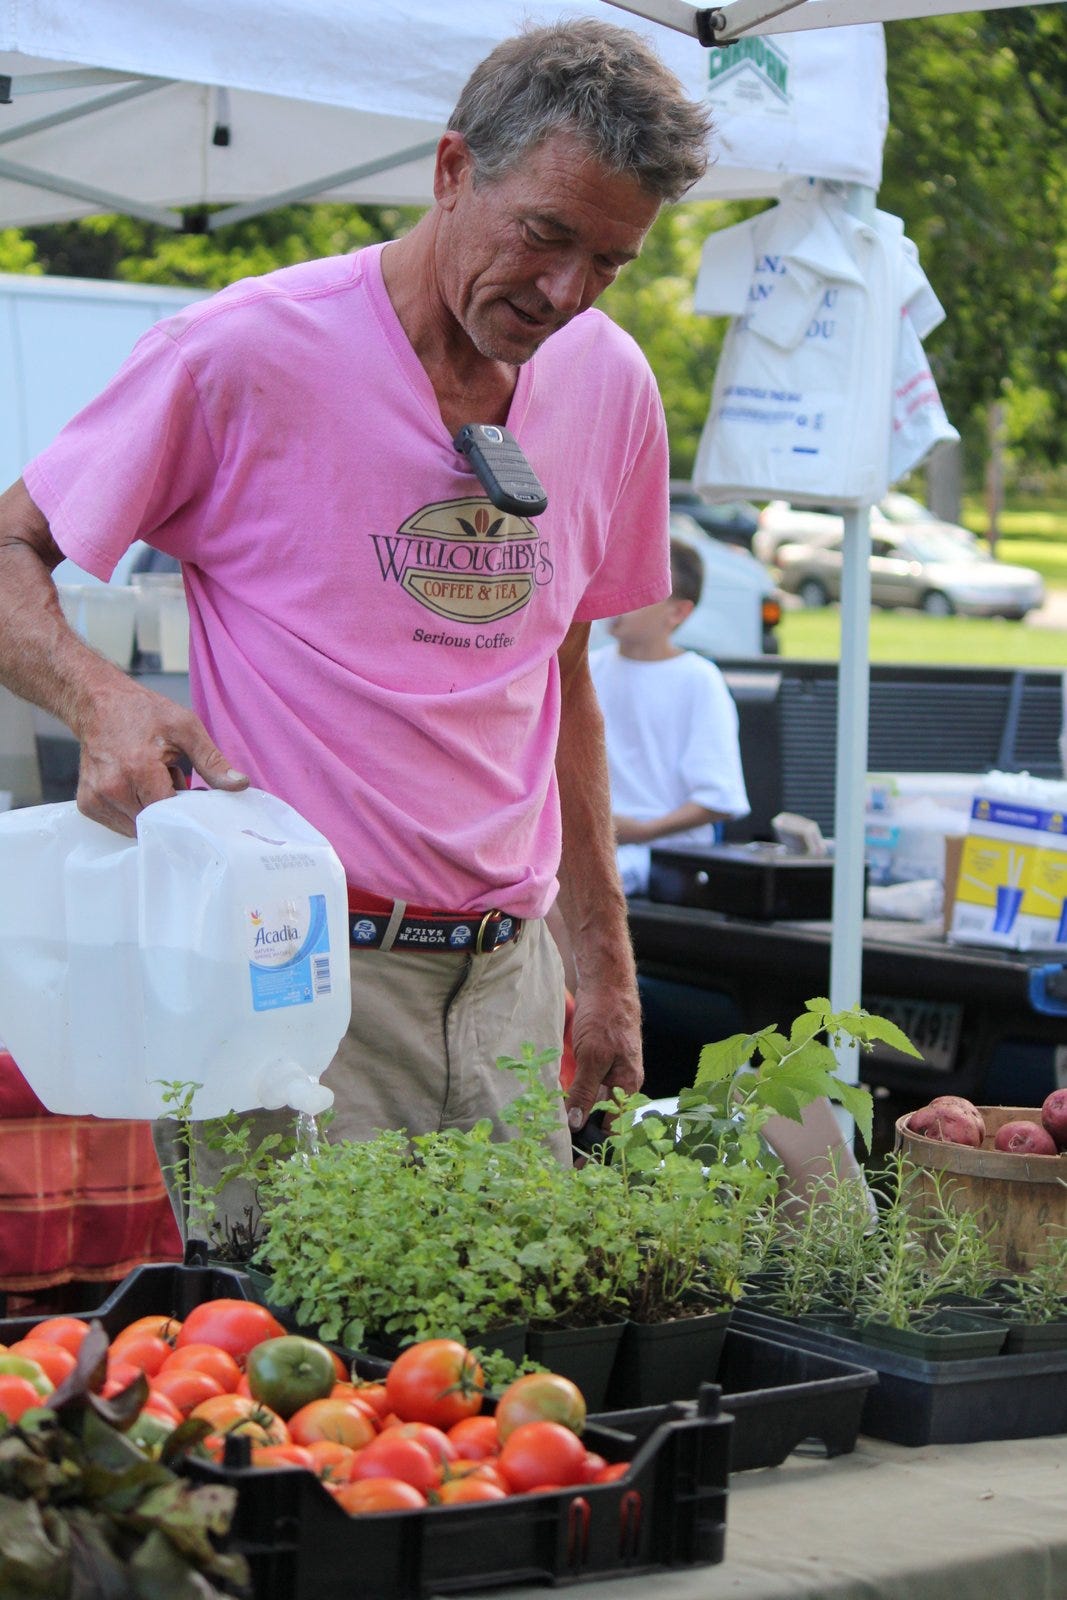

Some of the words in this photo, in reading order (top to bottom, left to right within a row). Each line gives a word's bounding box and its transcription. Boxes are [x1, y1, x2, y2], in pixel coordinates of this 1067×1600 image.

[368, 534, 554, 586] WILLOUGHBY'S
[423, 581, 473, 600] COFFEE
[477, 585, 491, 601] &
[496, 584, 518, 600] TEA
[412, 628, 471, 648] Serious
[254, 924, 299, 947] Acadia
[399, 932, 447, 944] NORTH
[405, 927, 444, 936] SAILS
